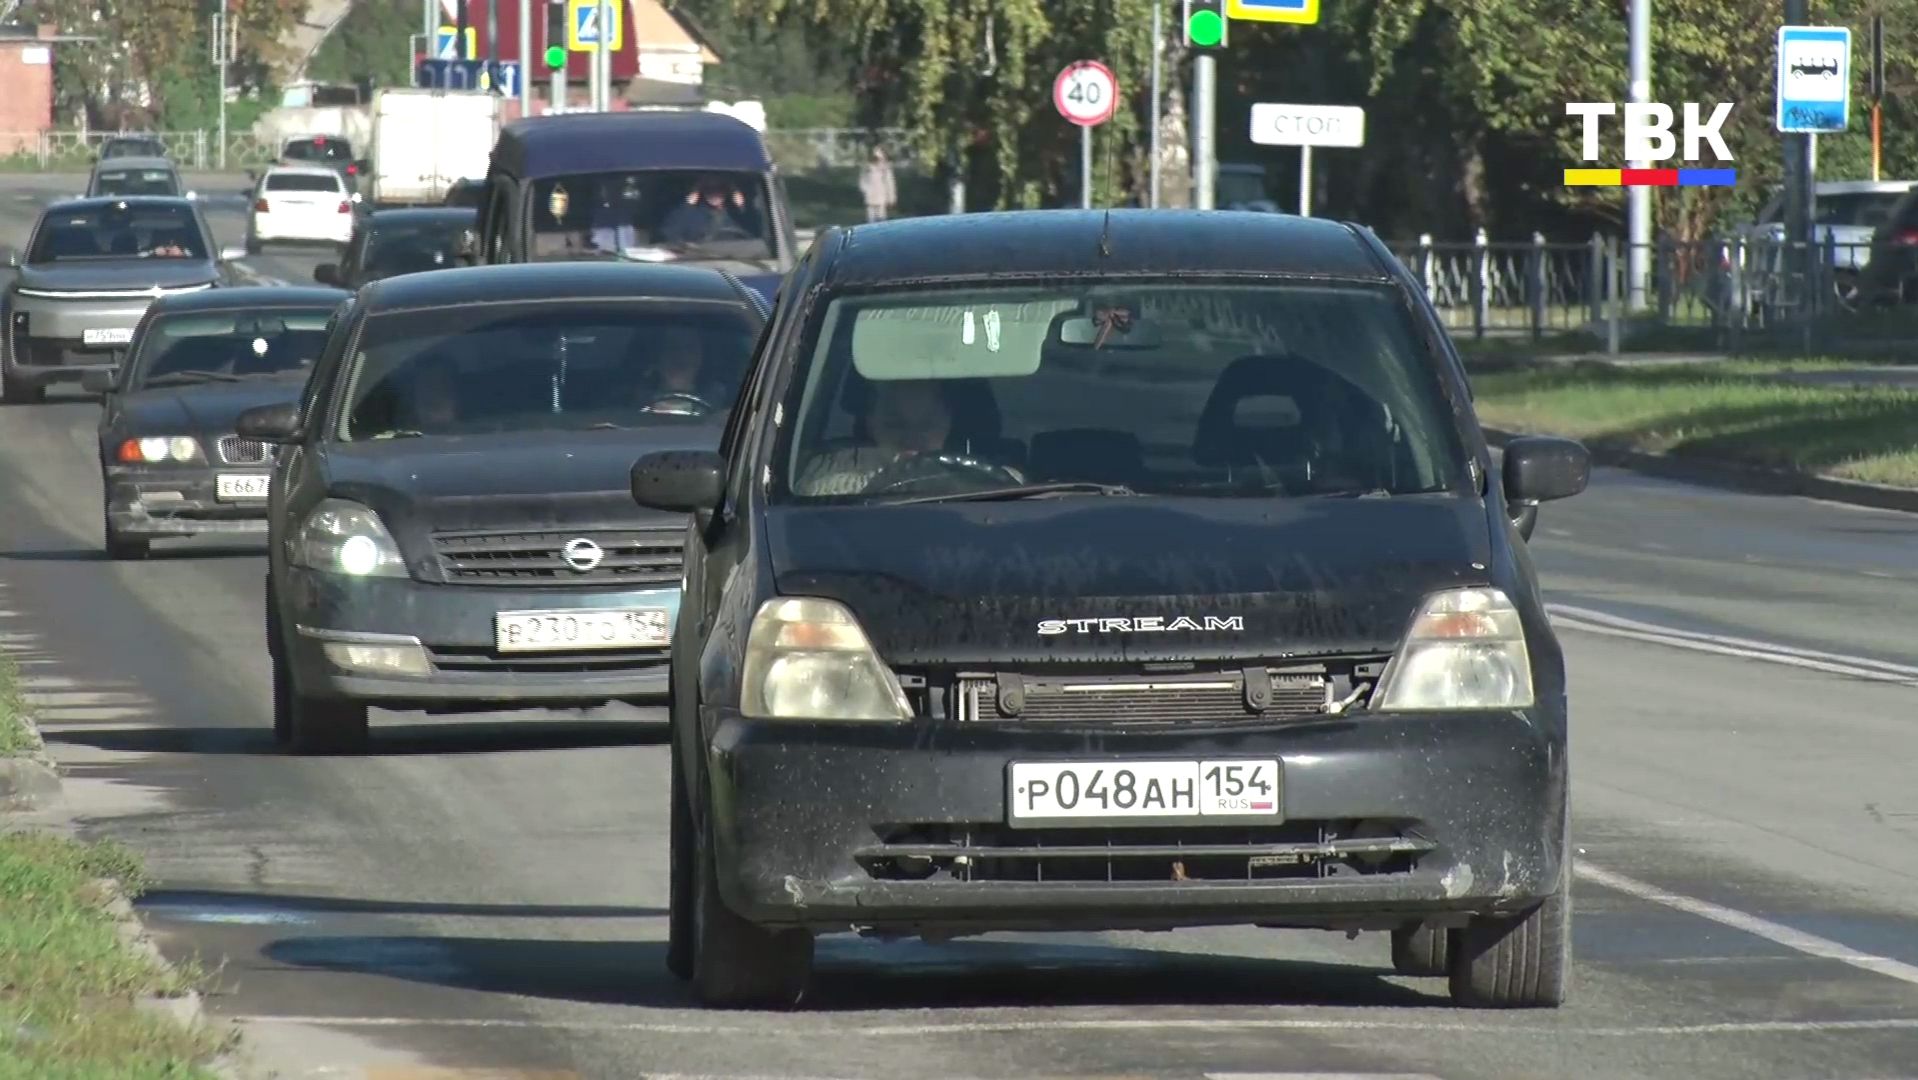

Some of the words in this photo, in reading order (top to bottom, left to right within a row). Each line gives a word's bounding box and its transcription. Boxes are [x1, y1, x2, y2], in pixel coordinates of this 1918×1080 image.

[1068, 82, 1101, 104] 40
[1274, 114, 1341, 135] СТОП
[1037, 616, 1244, 635] STREAM
[1027, 769, 1194, 810] Р048АН
[1205, 766, 1269, 797] 154
[1217, 798, 1249, 809] RUS
